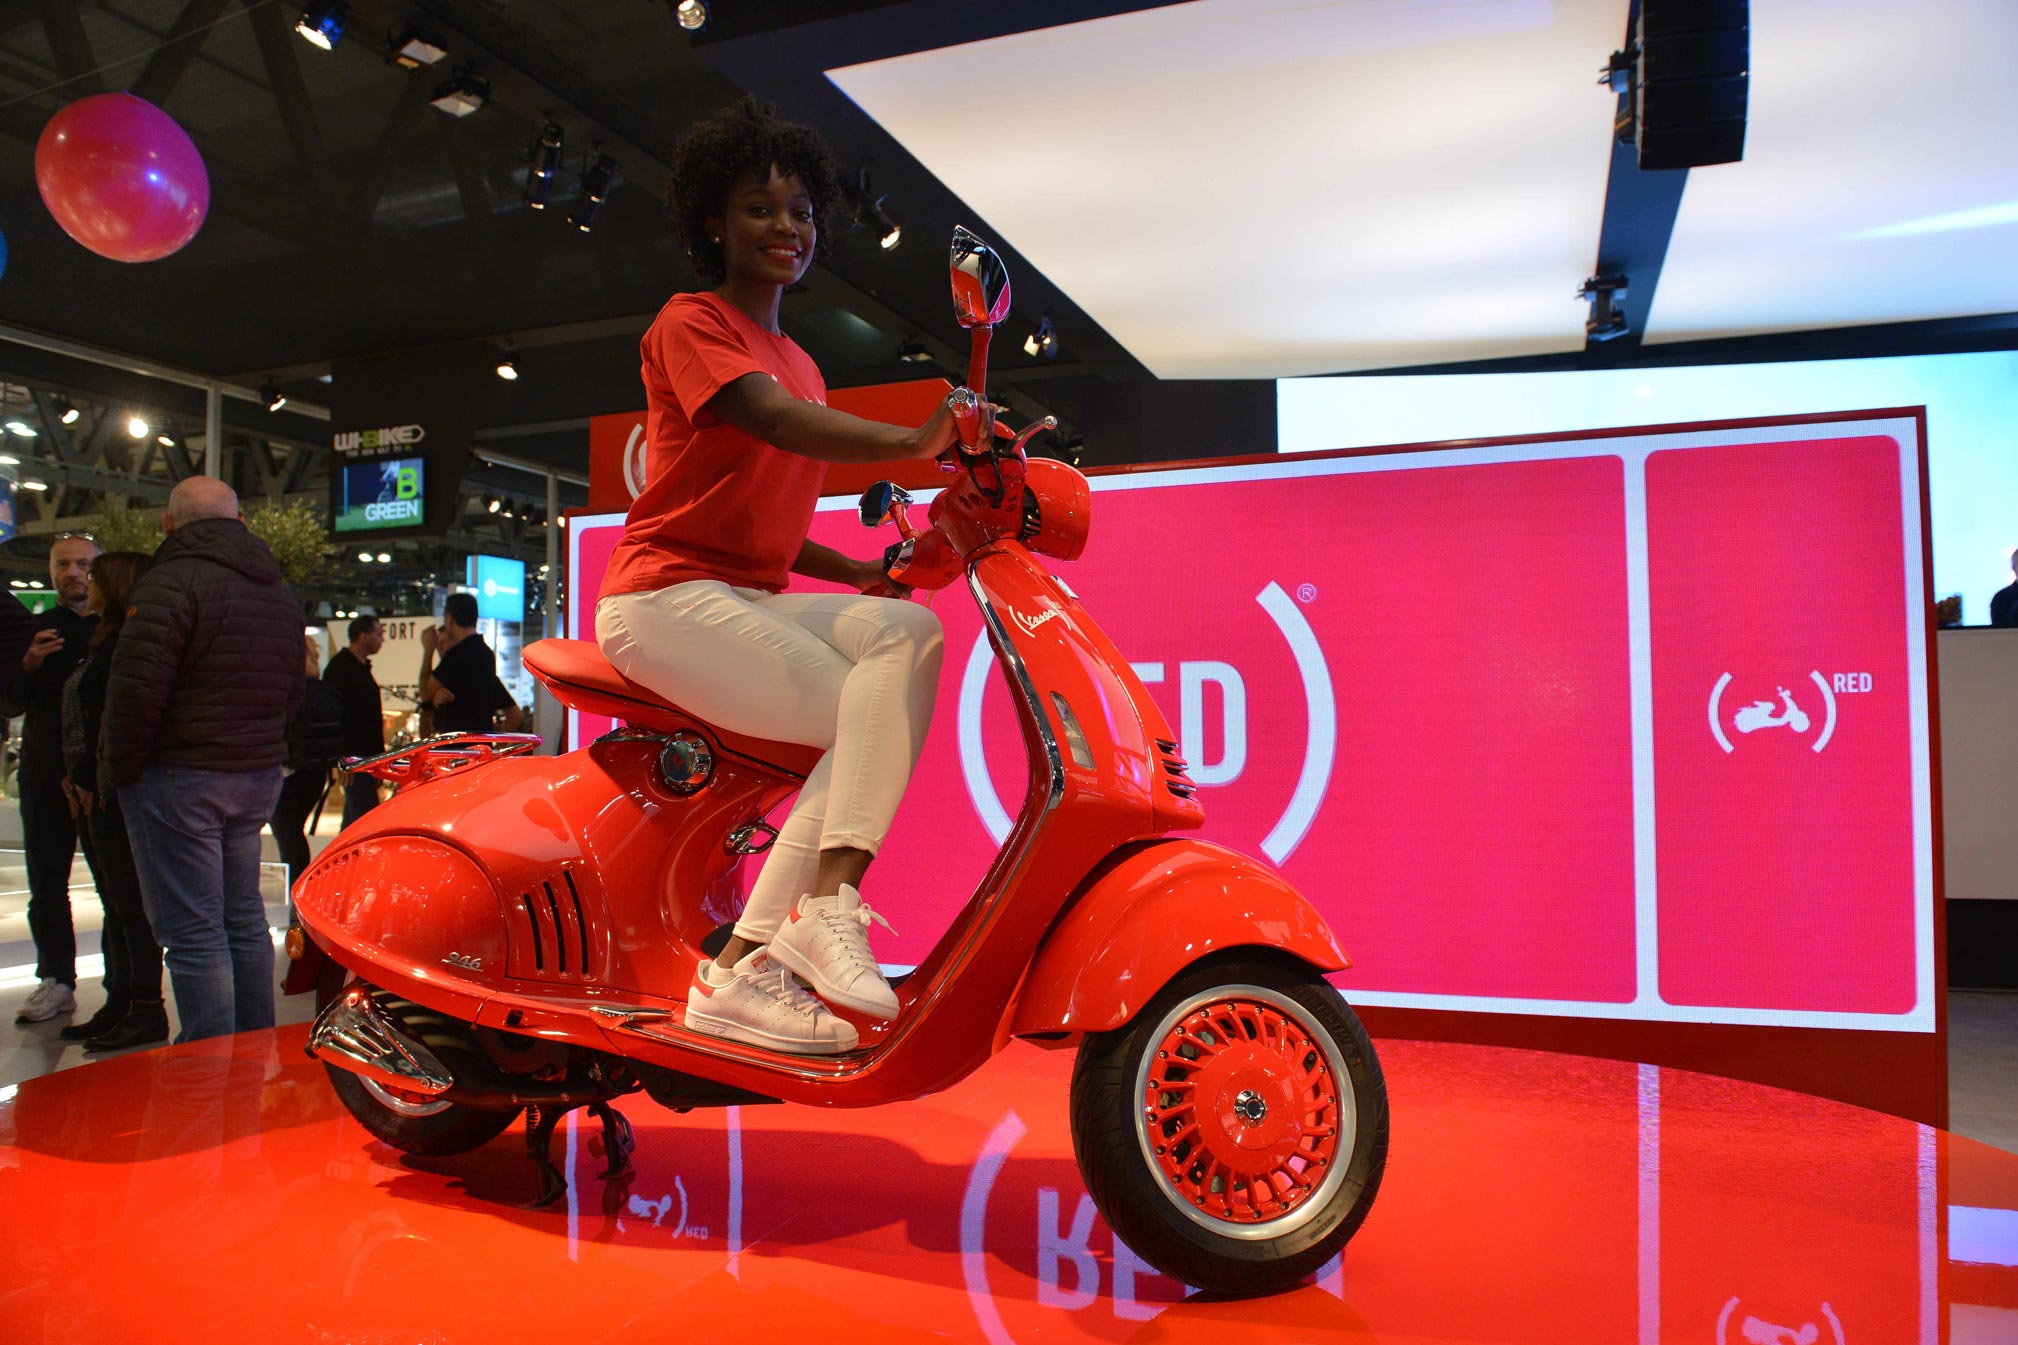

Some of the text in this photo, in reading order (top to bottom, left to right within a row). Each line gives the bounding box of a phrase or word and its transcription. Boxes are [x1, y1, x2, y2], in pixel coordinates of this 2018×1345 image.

[397, 467, 418, 500] B
[365, 500, 419, 522] GREEN
[1833, 672, 1873, 694] RED
